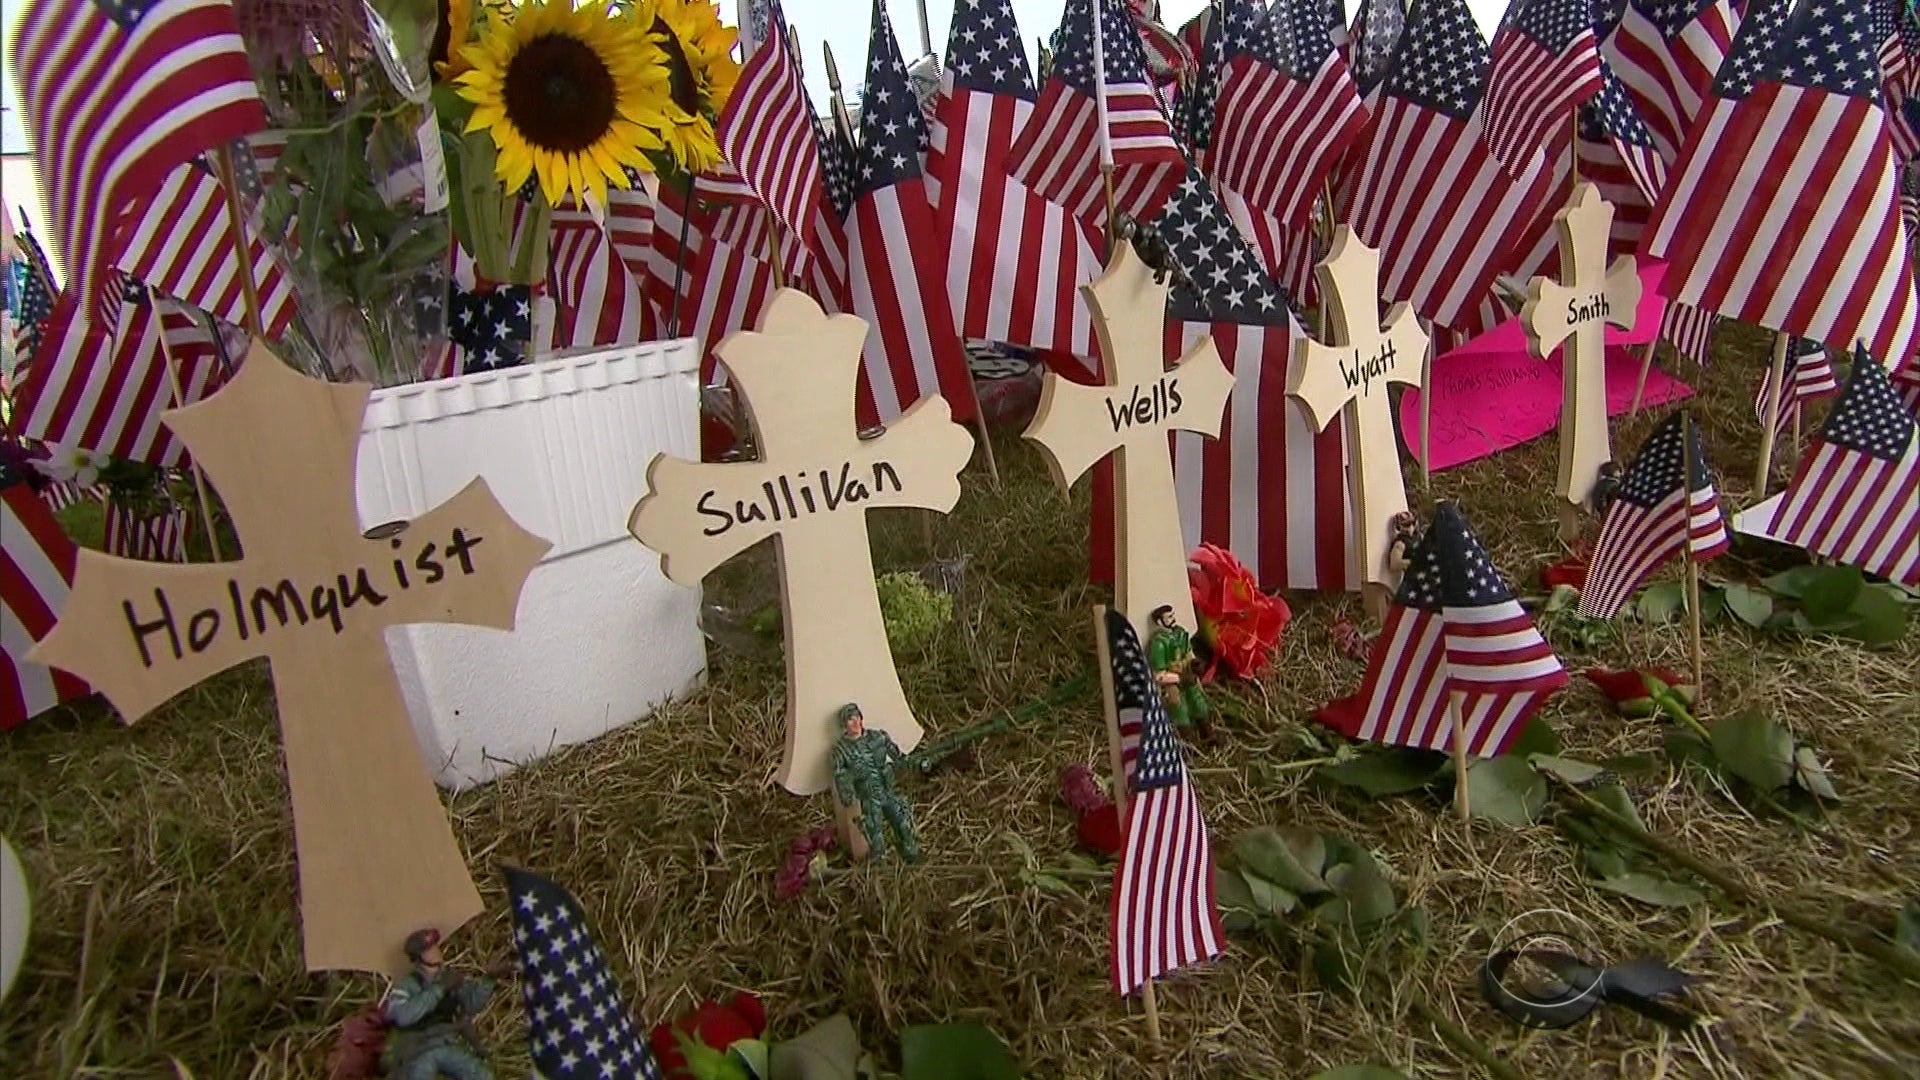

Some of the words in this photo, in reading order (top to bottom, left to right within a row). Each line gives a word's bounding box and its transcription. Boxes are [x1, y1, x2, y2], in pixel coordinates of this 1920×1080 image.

[1566, 292, 1610, 325] Smith
[1338, 338, 1397, 398] Wyatt
[1105, 377, 1182, 433] Wells
[121, 527, 484, 669] Holmquist
